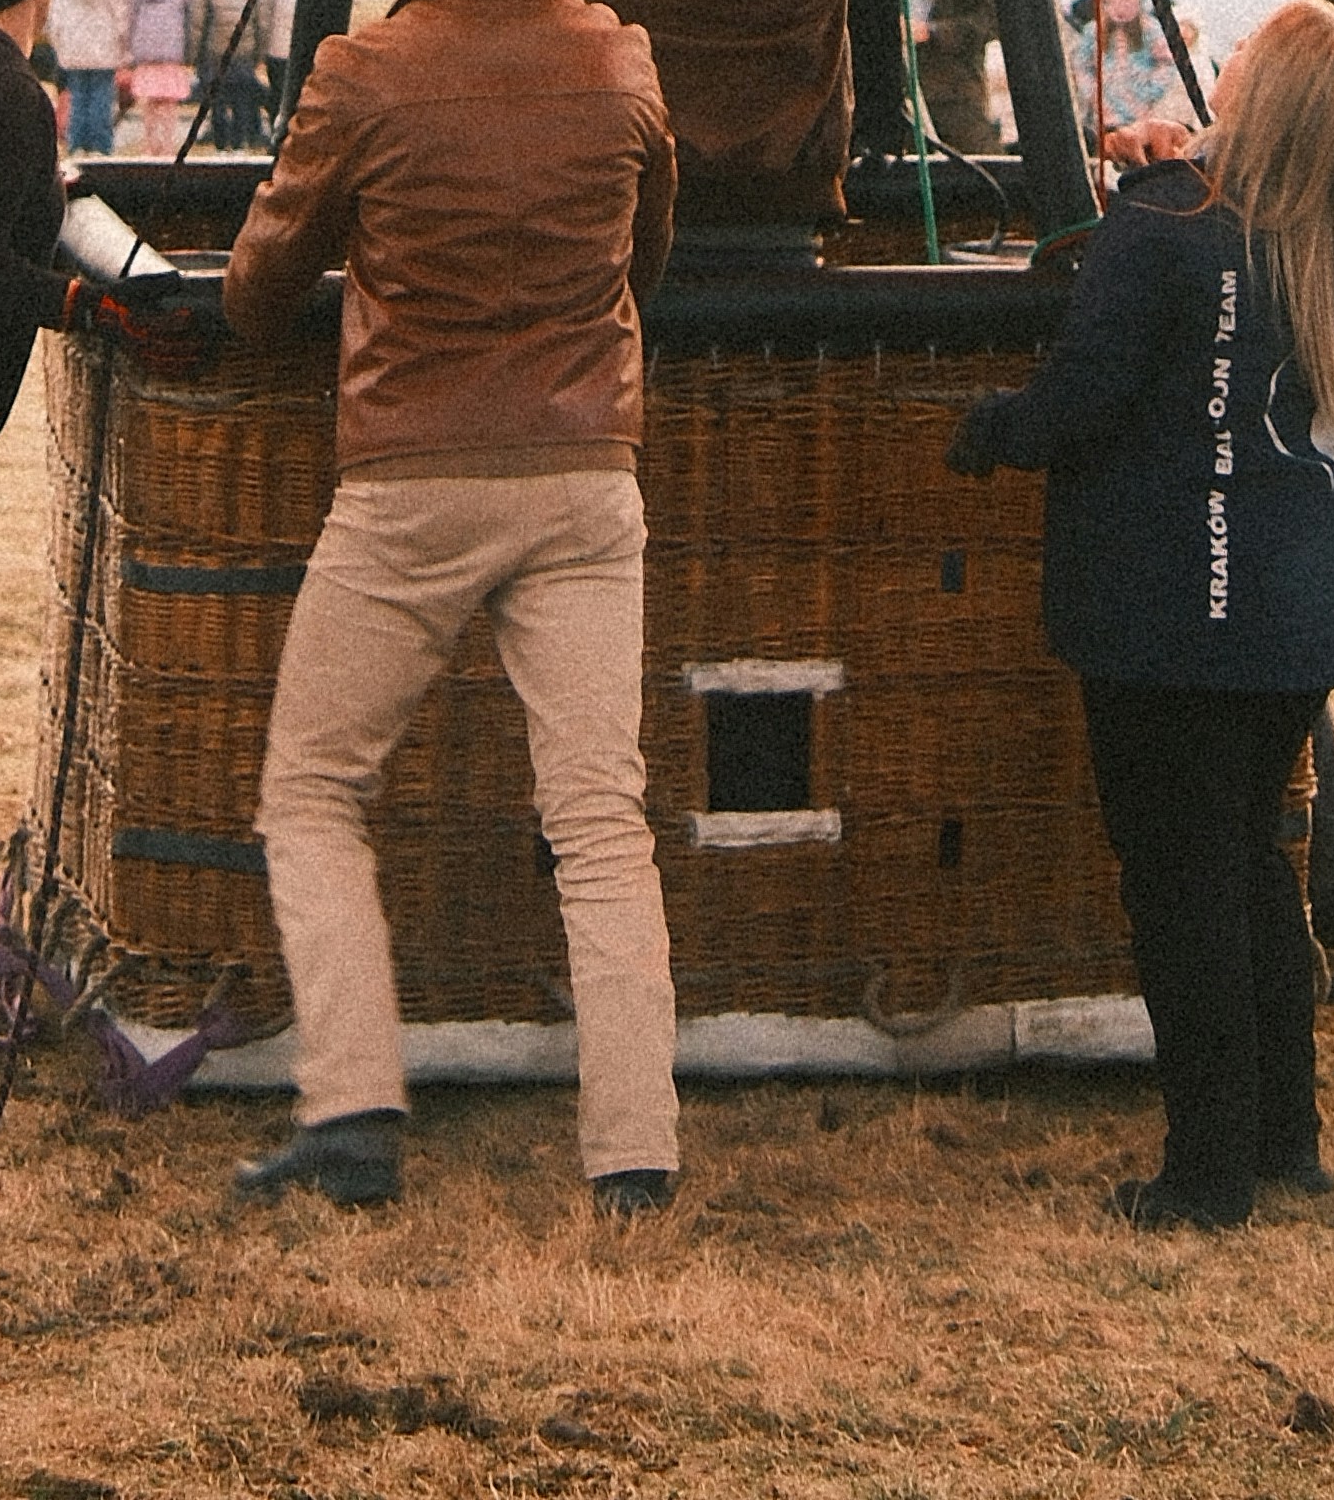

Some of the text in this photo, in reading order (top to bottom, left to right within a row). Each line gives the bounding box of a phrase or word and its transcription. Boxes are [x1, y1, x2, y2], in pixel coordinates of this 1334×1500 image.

[1207, 268, 1238, 620] KRAKÓW BALOON TEAM
